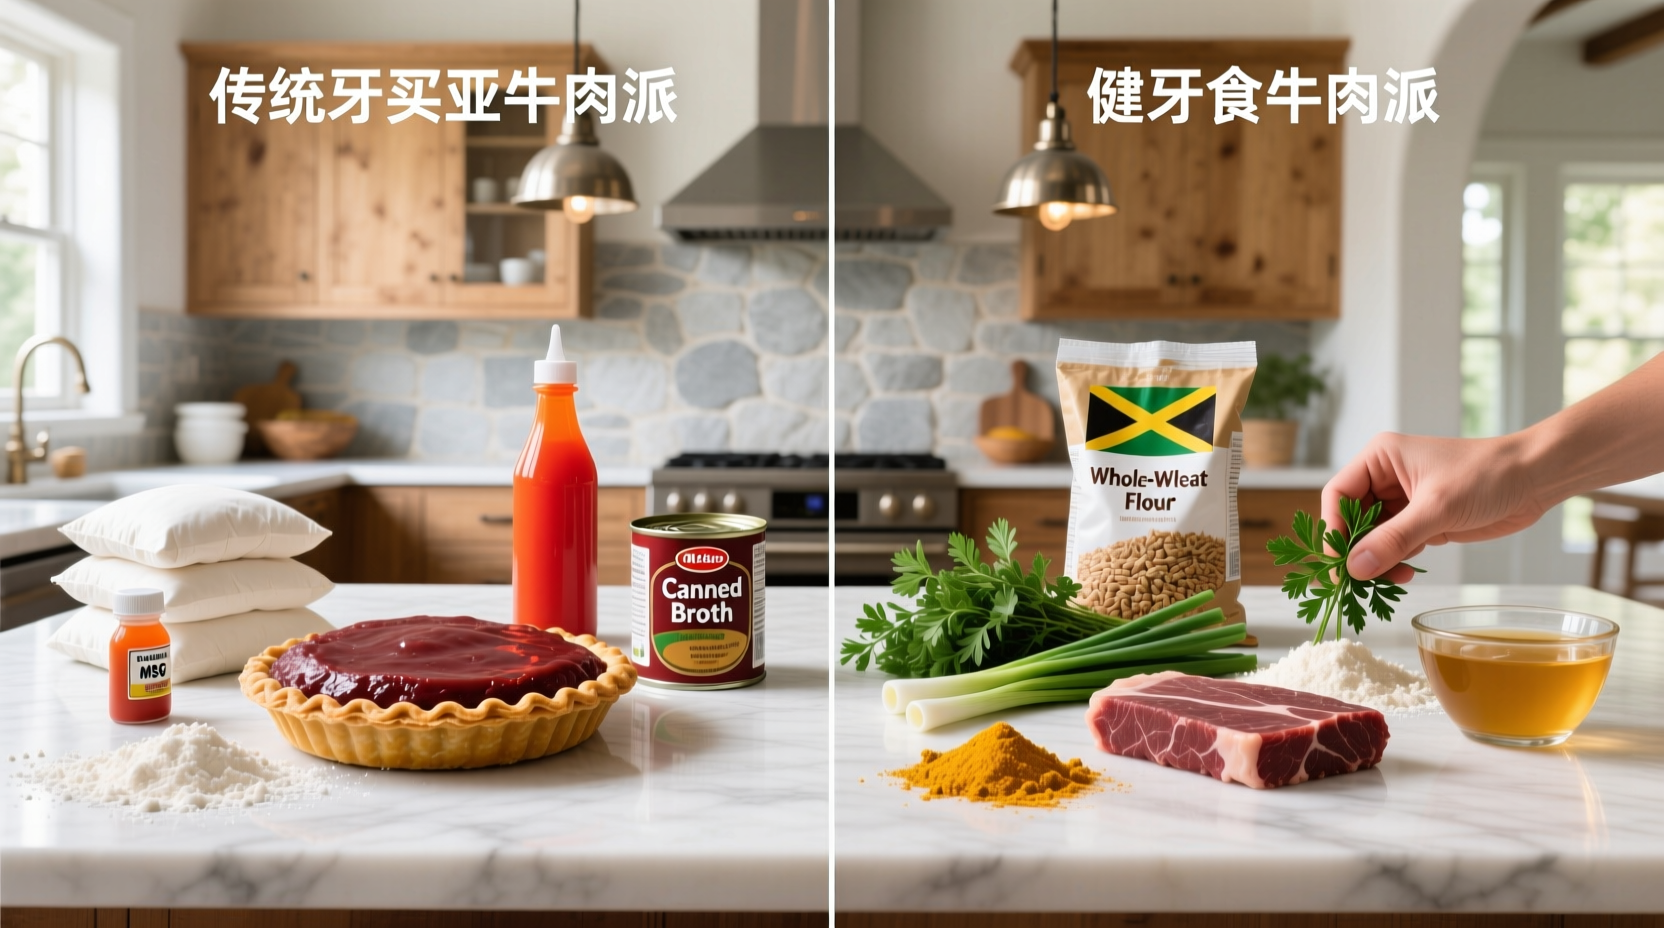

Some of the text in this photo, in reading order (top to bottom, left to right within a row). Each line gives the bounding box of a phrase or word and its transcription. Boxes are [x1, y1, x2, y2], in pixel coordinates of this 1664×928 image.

[1125, 492, 1176, 512] Flour
[662, 576, 742, 600] Canned
[671, 601, 733, 624] Broth
